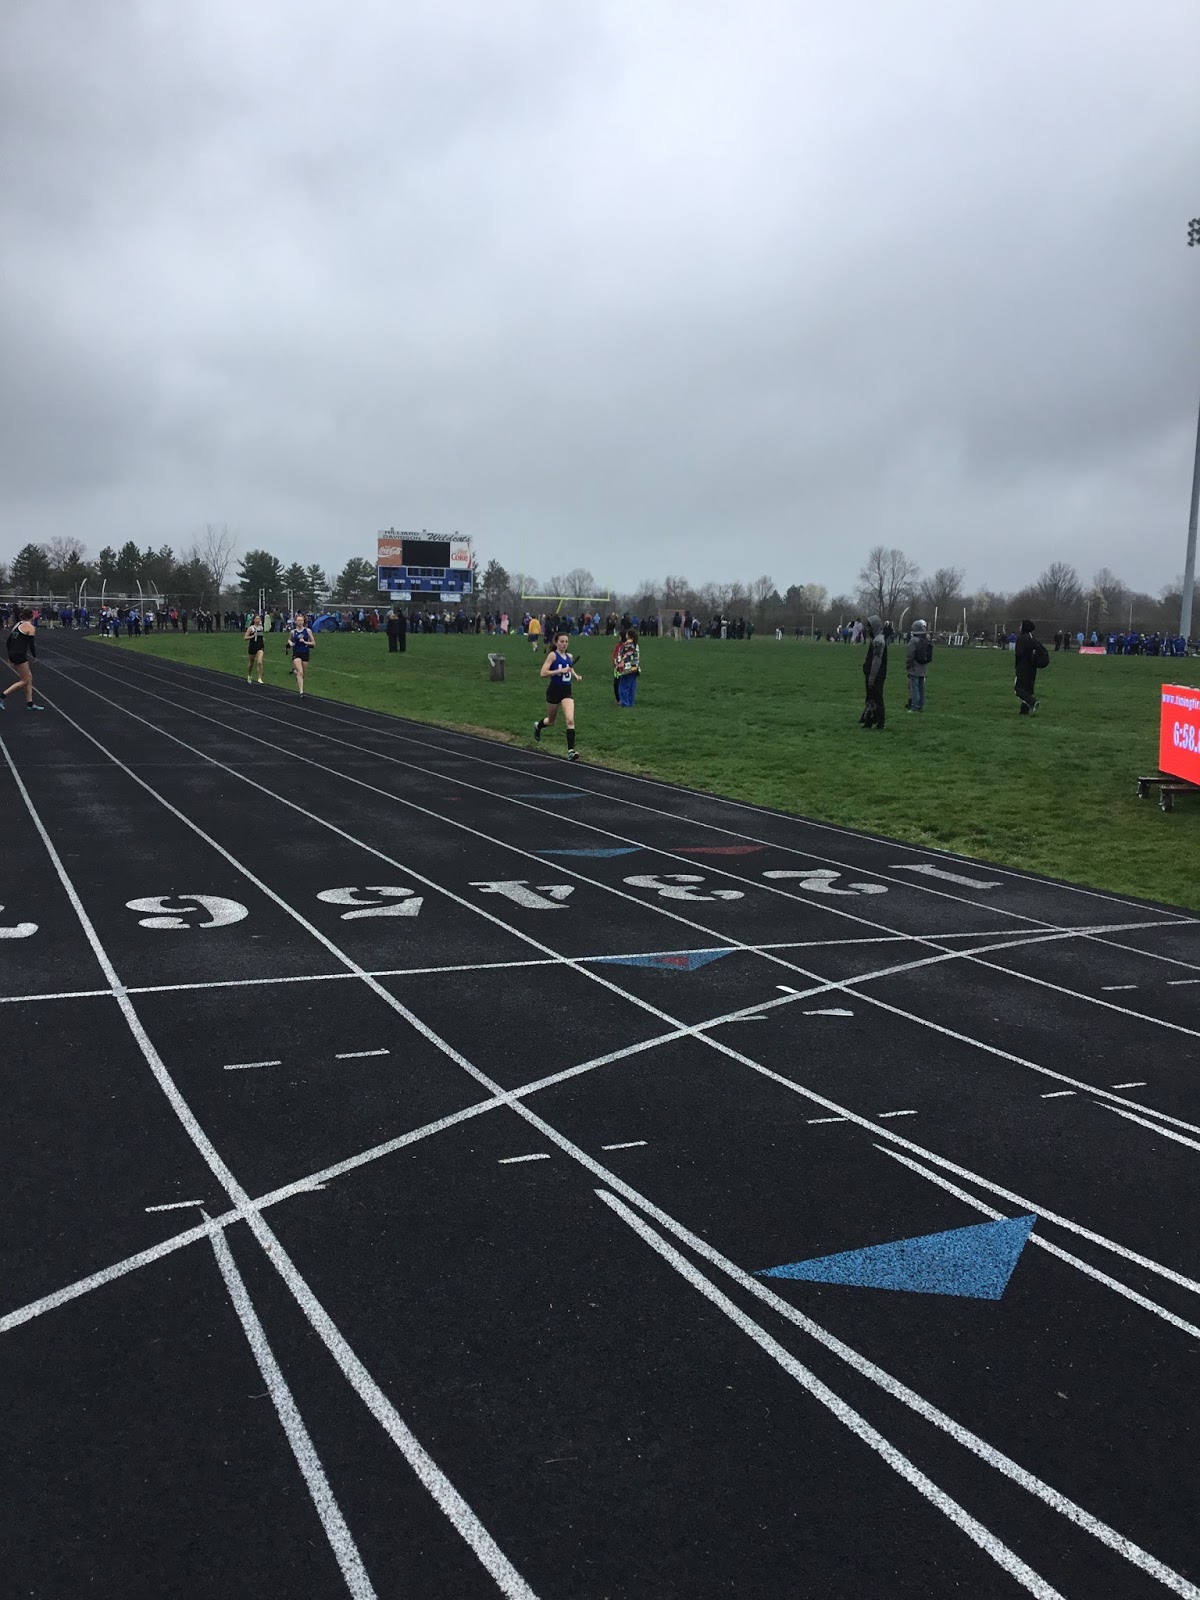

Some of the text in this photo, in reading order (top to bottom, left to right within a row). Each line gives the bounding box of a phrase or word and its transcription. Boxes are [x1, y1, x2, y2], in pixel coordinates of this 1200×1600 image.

[427, 533, 470, 542] Wildcats
[451, 553, 468, 561] Coke
[622, 873, 745, 902] 3
[762, 868, 888, 896] 2
[888, 864, 1004, 890] 1
[316, 886, 424, 921] 5
[468, 879, 575, 910] 4
[125, 894, 249, 930] 6
